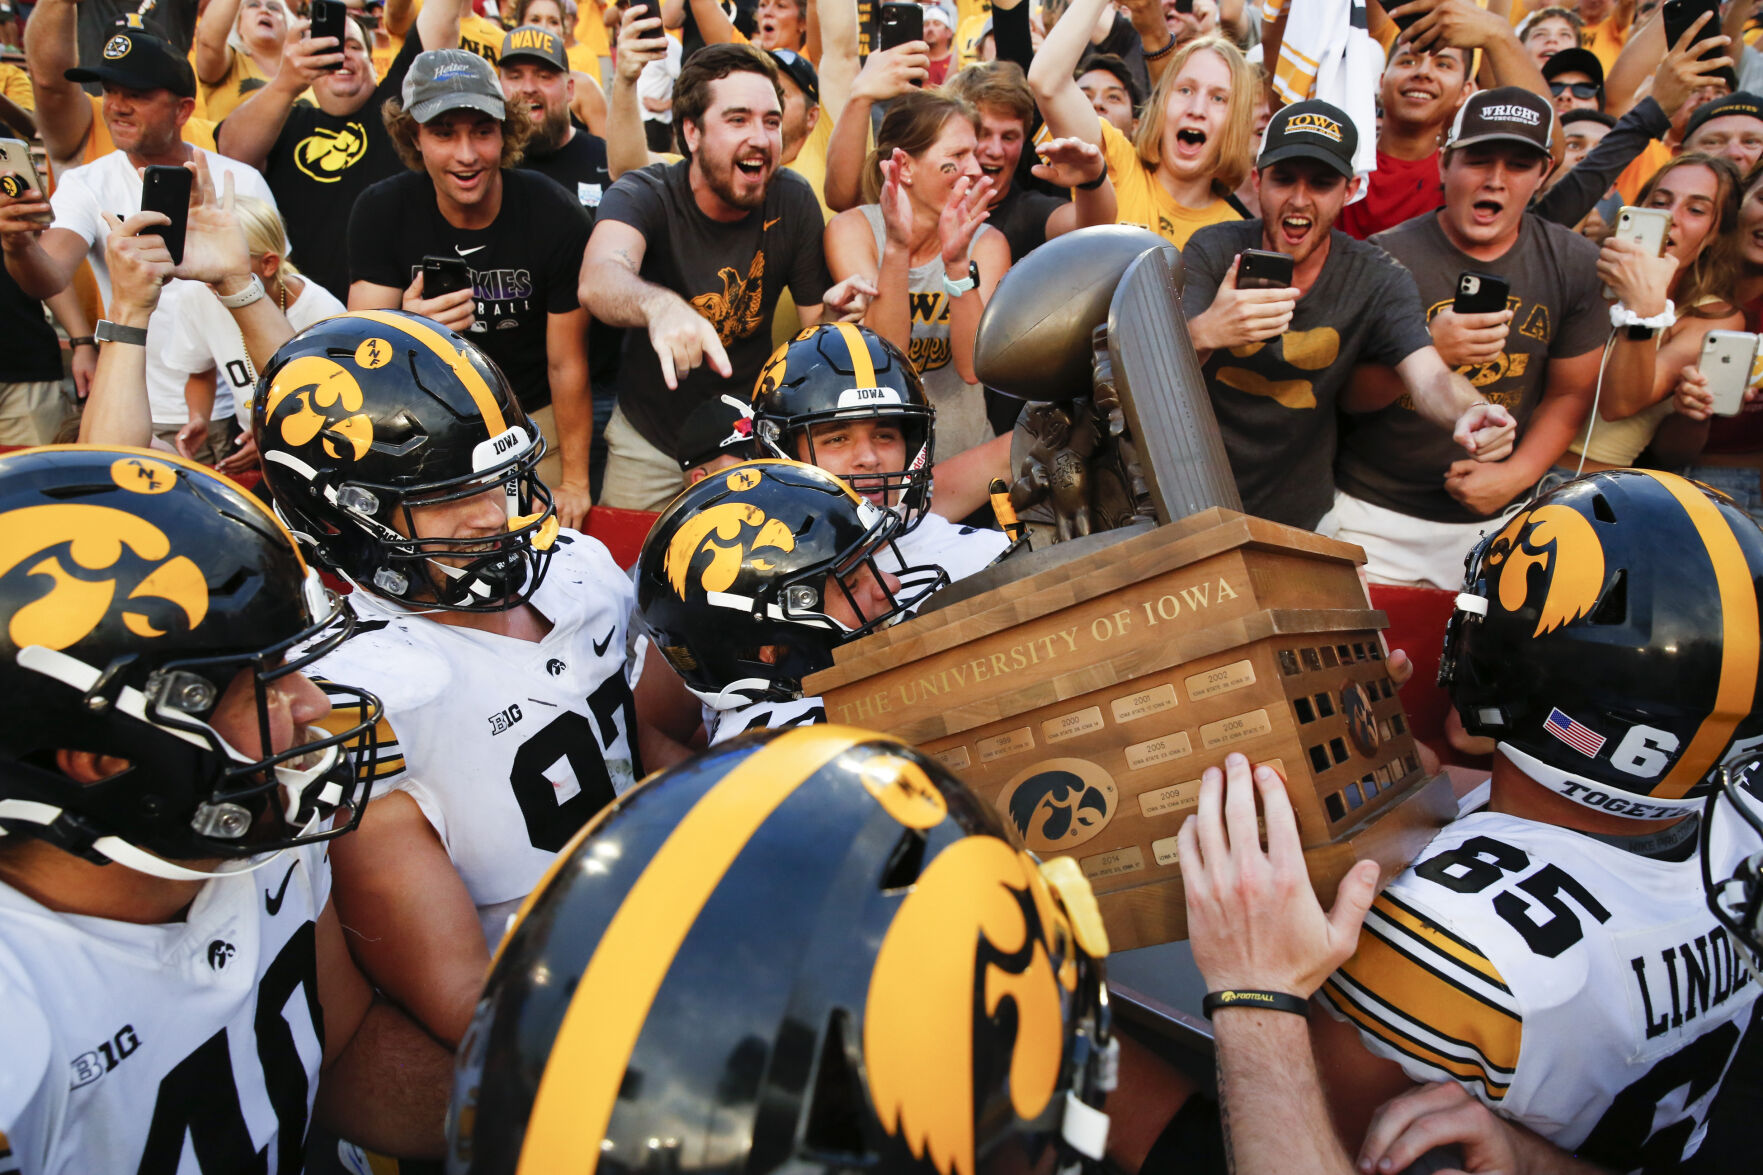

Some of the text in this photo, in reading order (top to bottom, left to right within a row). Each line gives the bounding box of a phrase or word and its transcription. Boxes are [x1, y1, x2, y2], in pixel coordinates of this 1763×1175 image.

[510, 30, 553, 54] WAVE
[1482, 104, 1540, 122] WRIGHT
[1287, 115, 1343, 137] IOWA
[857, 389, 885, 400] IOWA
[493, 432, 519, 455] IOWA
[732, 470, 756, 489] ANF
[838, 576, 1239, 725] THE UNIVERSITY OF IOWA
[1208, 671, 1228, 683] 2002
[1061, 716, 1080, 727] 2000
[1222, 720, 1244, 731] 2006
[1146, 742, 1166, 752] 2005
[1610, 724, 1680, 778] 6
[1160, 789, 1180, 800] 2009
[1102, 855, 1120, 865] 2014
[1415, 835, 1612, 959] 65
[1236, 992, 1275, 1002] FOOTBALL
